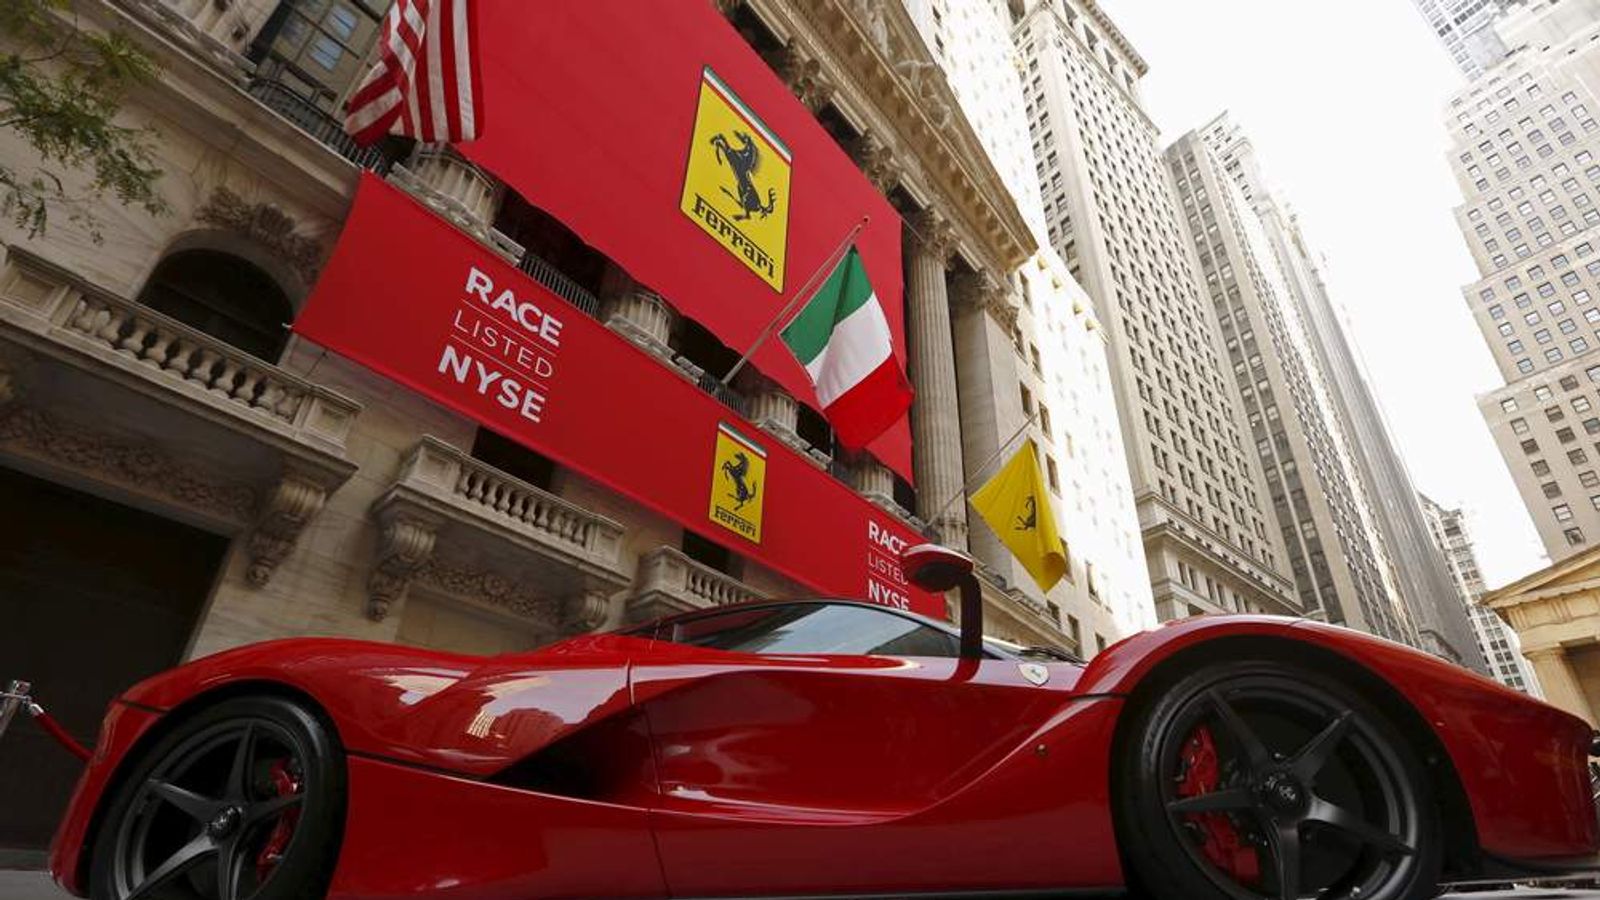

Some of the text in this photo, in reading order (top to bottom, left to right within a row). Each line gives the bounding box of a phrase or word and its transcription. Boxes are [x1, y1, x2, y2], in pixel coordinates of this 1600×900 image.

[692, 193, 774, 279] Ferrari
[453, 309, 553, 378] LISTED
[465, 267, 563, 347] RACE
[438, 344, 546, 423] NYSE
[714, 504, 756, 537] Ferrari
[868, 578, 910, 611] NYSE
